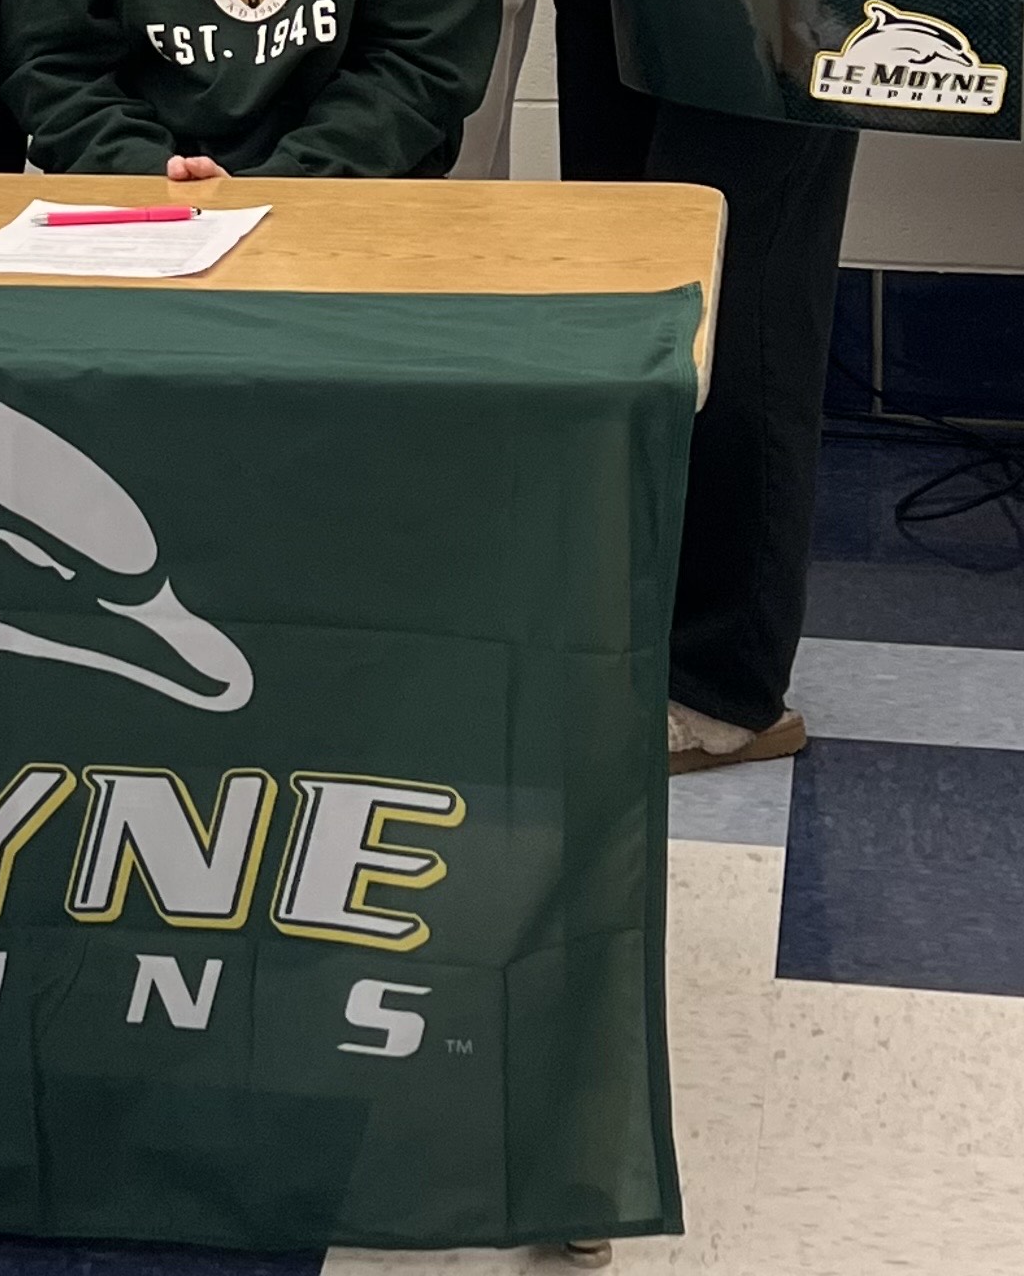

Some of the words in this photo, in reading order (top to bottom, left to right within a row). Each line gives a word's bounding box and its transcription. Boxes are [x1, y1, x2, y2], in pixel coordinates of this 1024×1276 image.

[146, 24, 234, 65] EST.
[820, 59, 866, 83] LE
[871, 62, 999, 94] MOYNE
[819, 82, 994, 106] DOLPHINS
[444, 1039, 474, 1055] TM
